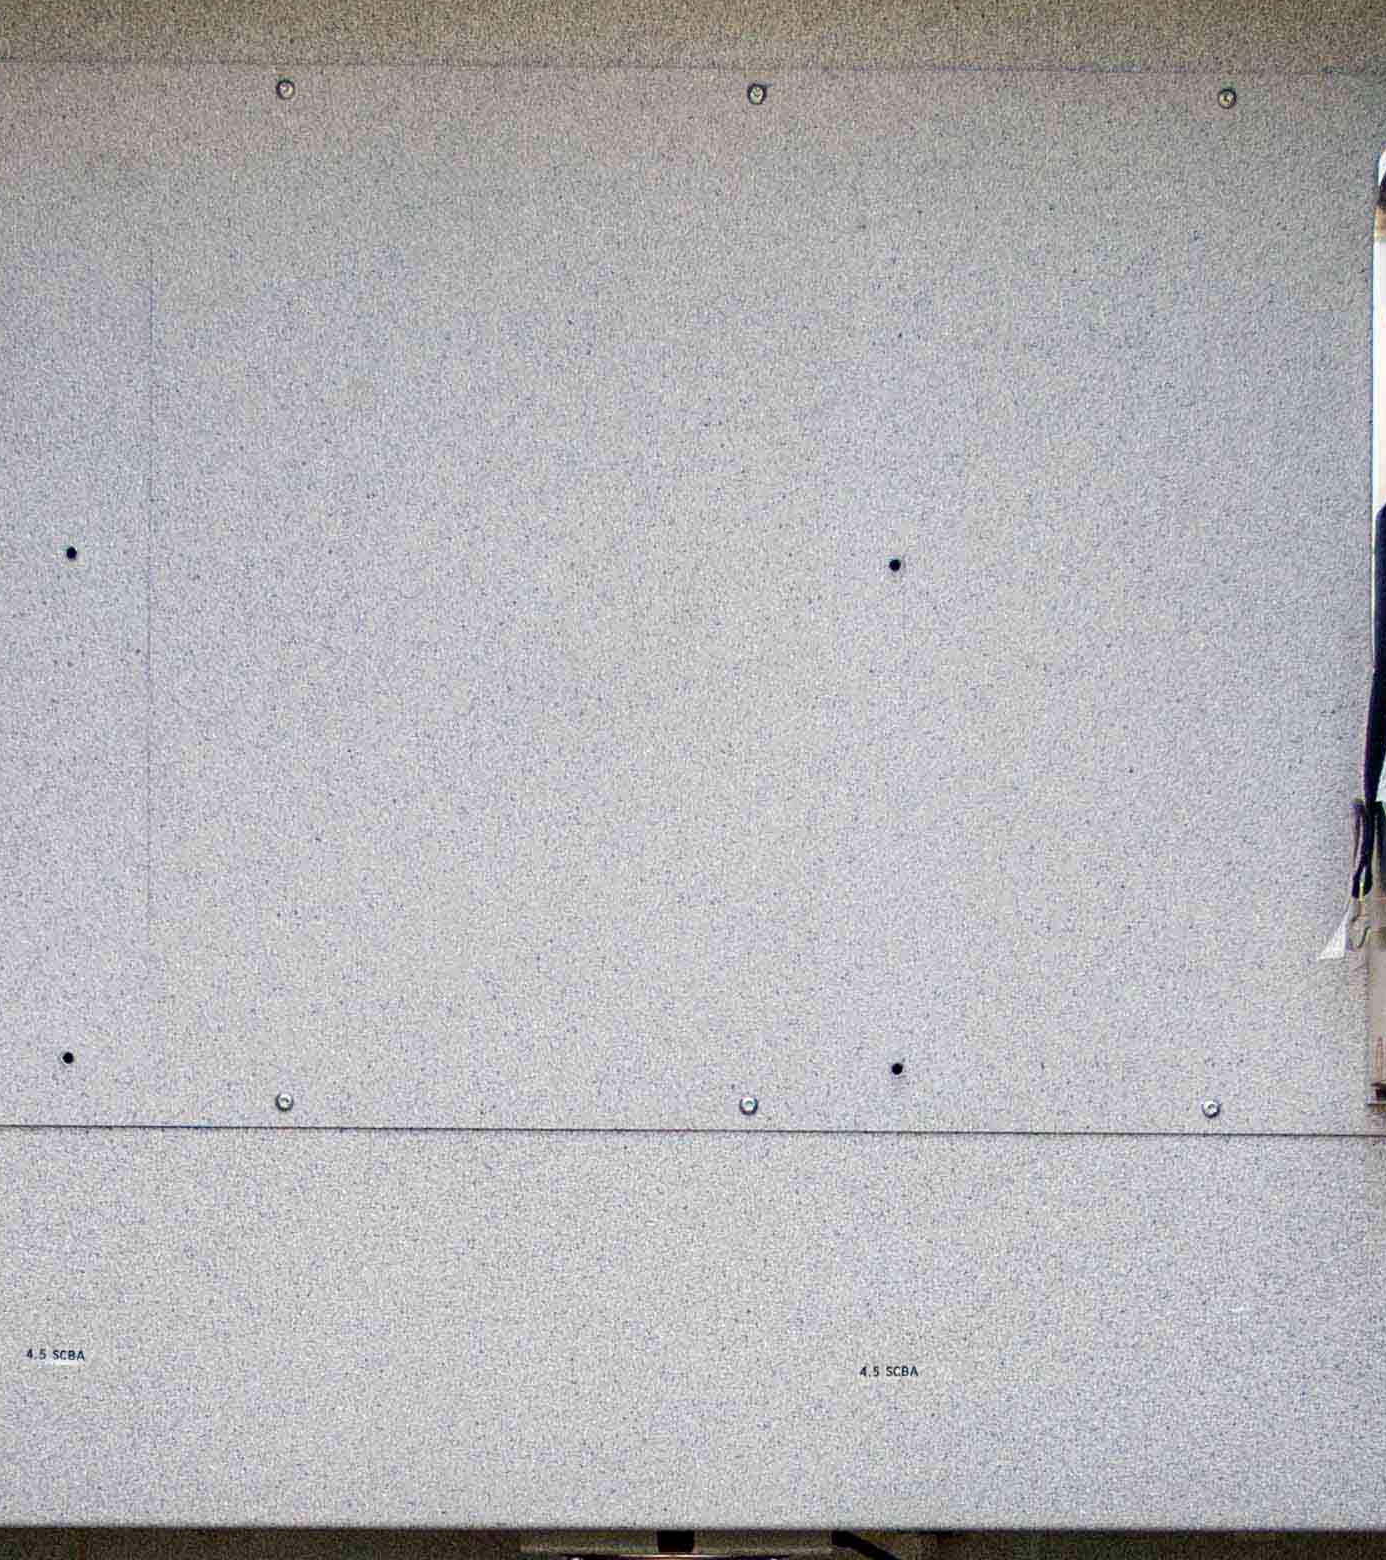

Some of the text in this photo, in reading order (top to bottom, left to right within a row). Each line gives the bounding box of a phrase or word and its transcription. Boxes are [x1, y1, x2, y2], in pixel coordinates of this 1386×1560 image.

[27, 1348, 85, 1361] 4.5 SCBA
[860, 1365, 919, 1378] 4.5 SCBA
